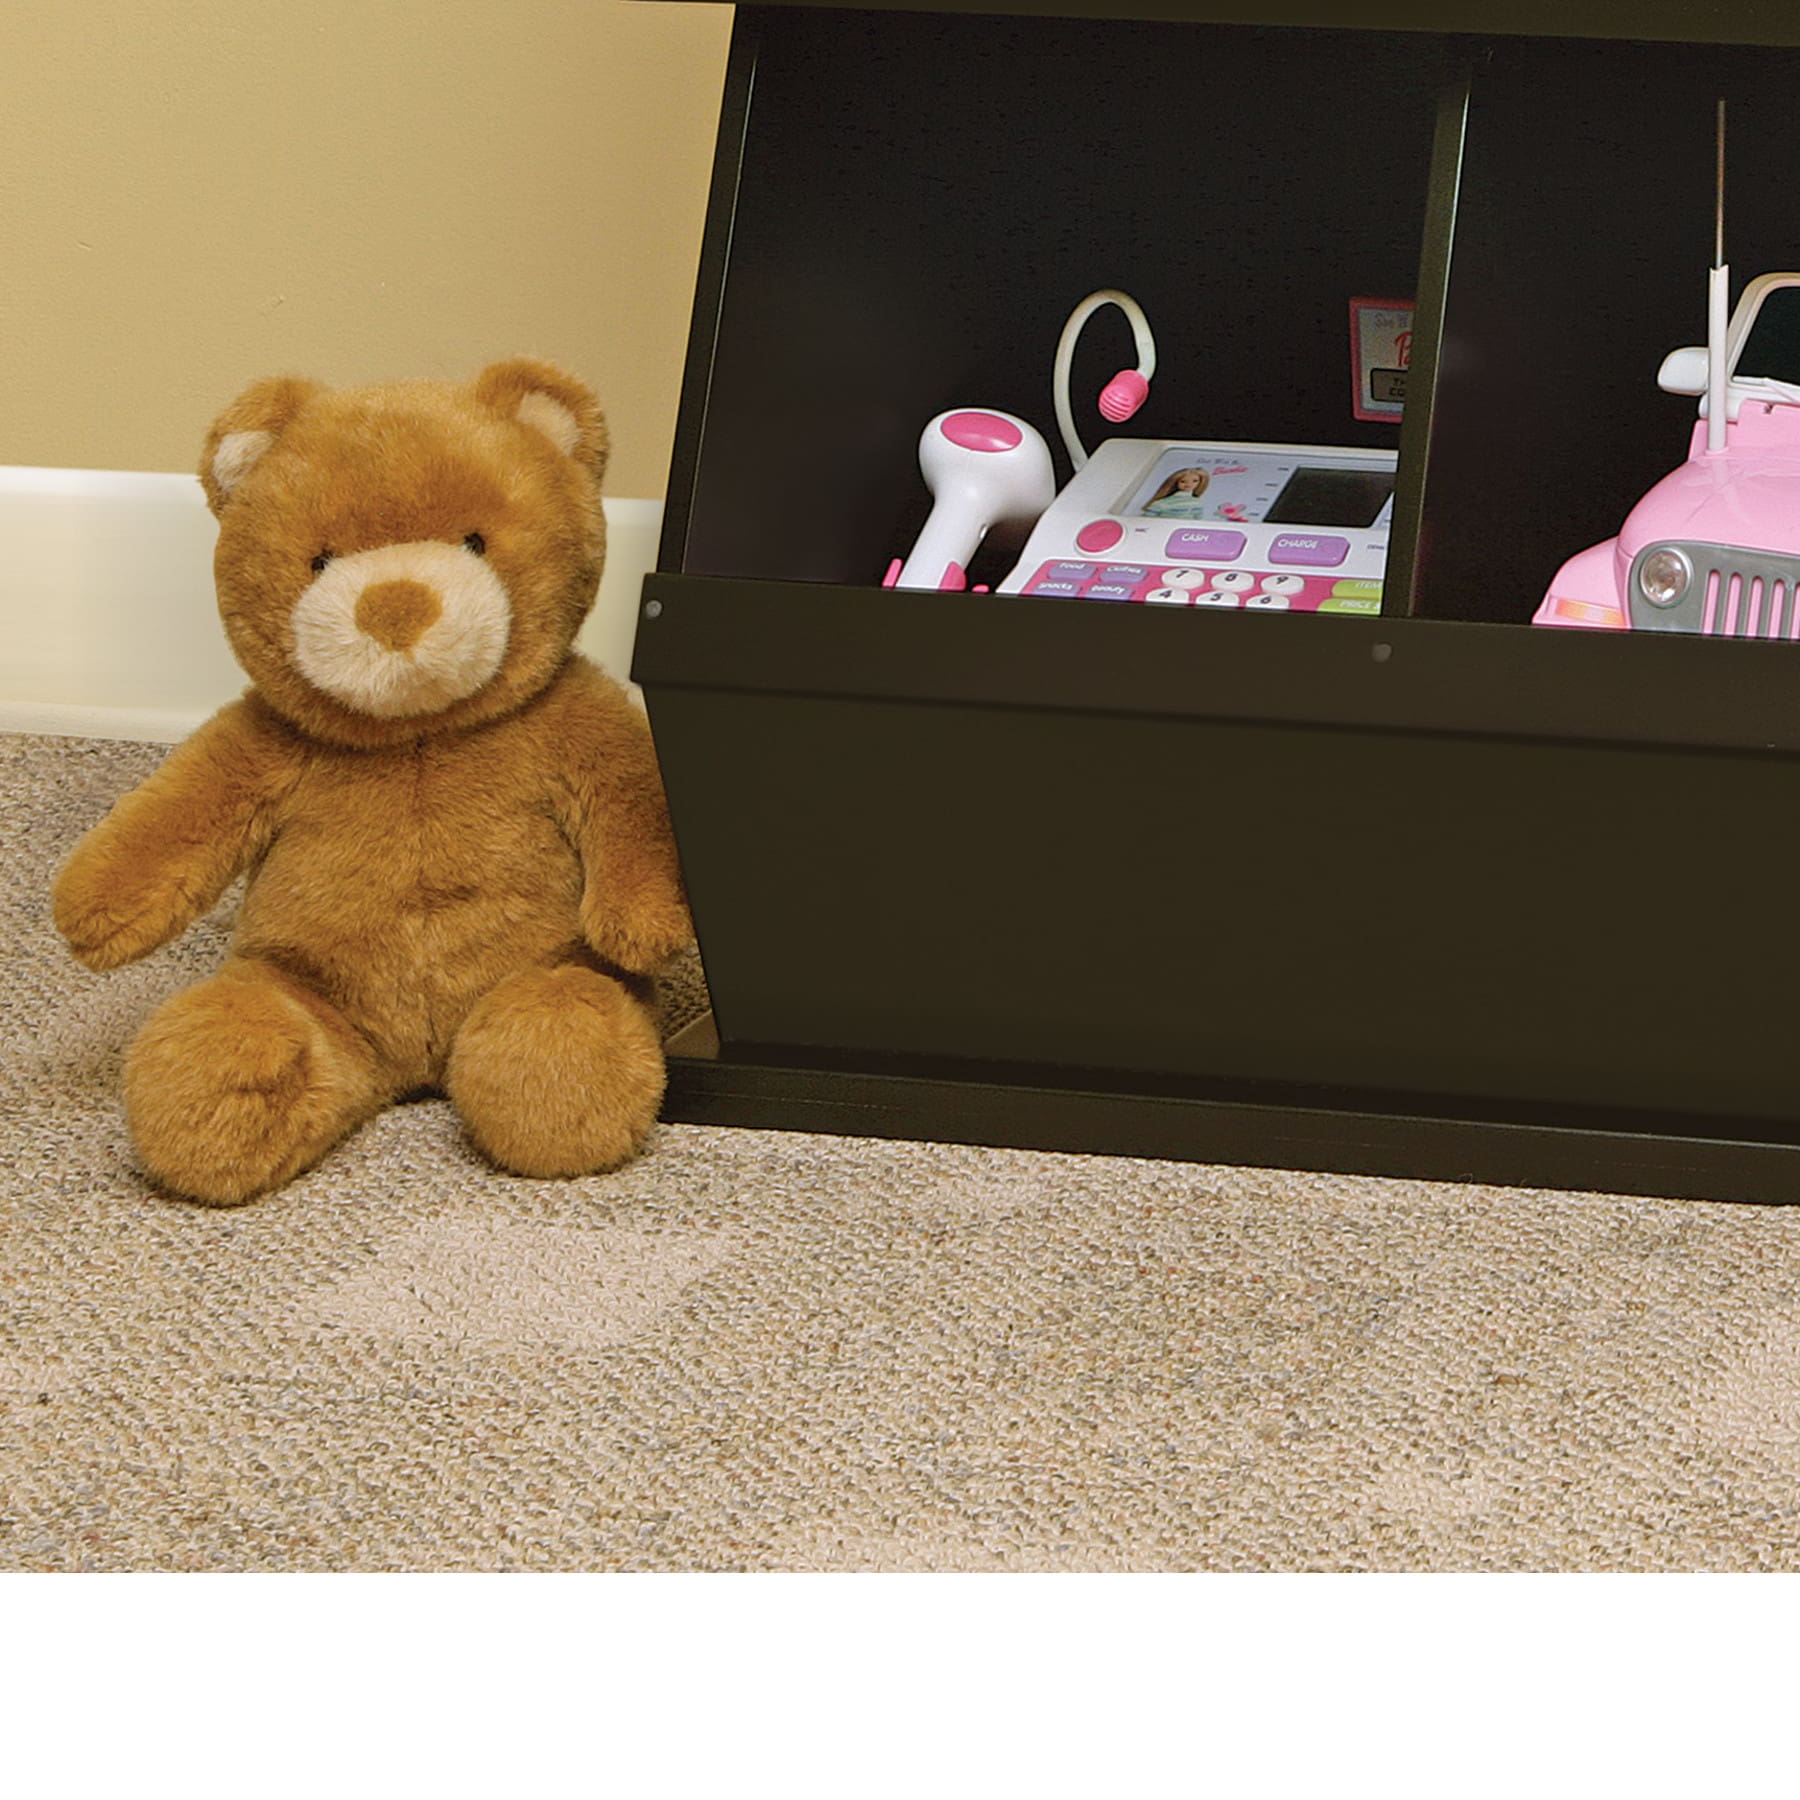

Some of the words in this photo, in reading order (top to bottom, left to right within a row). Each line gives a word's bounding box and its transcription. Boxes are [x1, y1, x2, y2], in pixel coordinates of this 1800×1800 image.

[1181, 533, 1210, 543] CASH
[1278, 538, 1319, 549] CHARGE
[1175, 569, 1189, 578] 7
[1224, 573, 1238, 582] 8
[1276, 575, 1289, 585] 9
[1158, 589, 1173, 599] 4
[1210, 592, 1224, 602] 5
